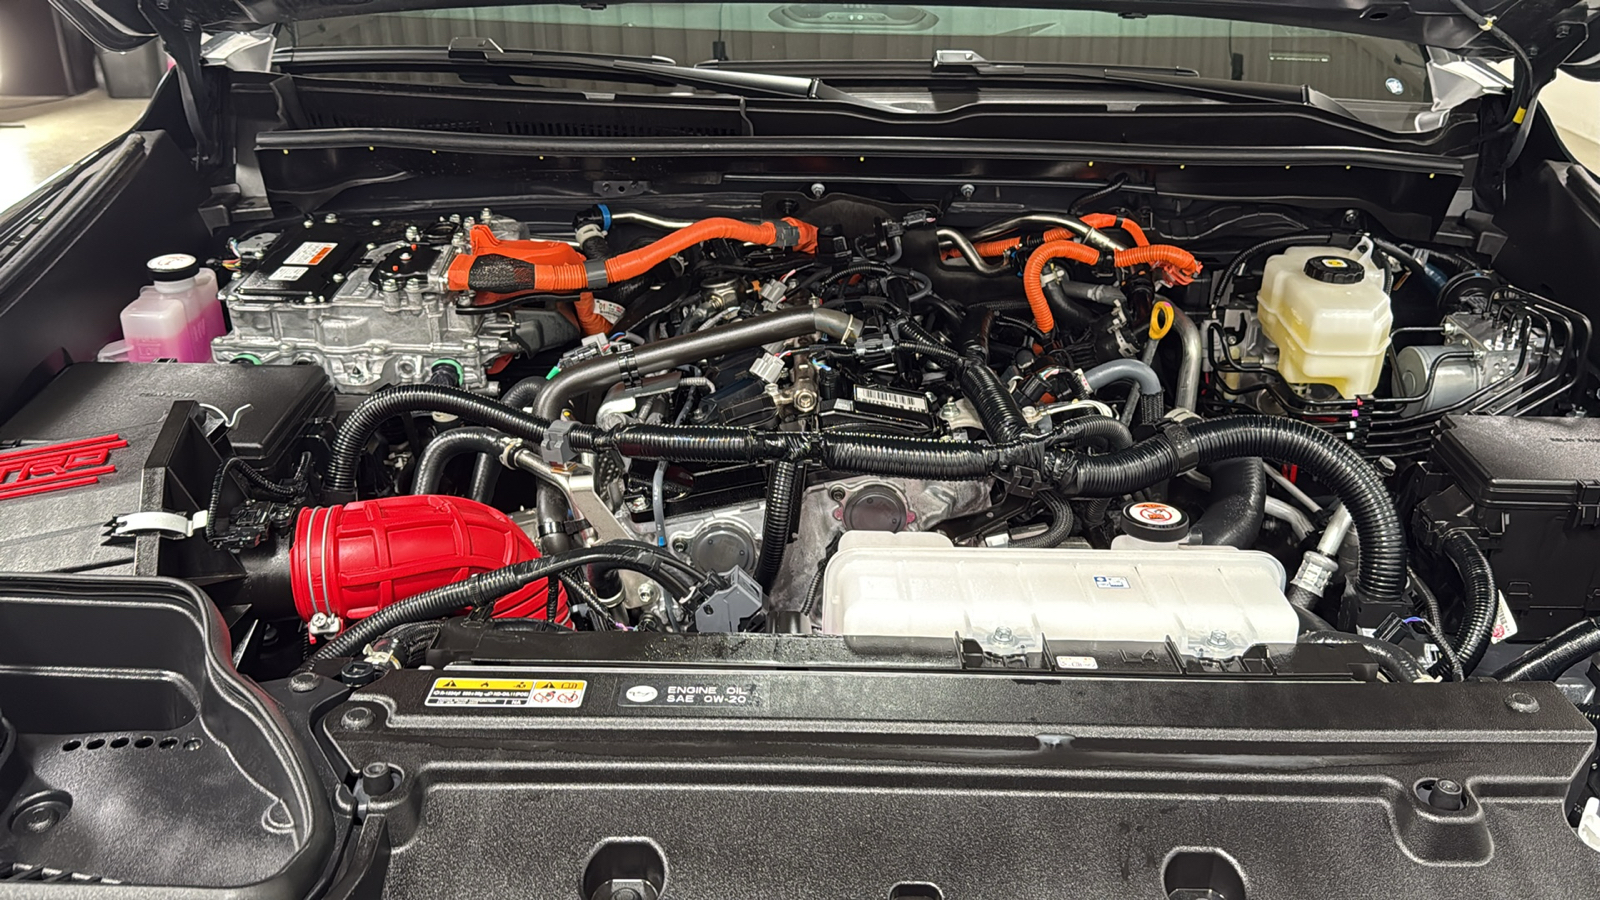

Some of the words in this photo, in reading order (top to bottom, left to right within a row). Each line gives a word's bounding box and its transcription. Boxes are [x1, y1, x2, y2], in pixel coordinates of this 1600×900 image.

[667, 685, 718, 695] ENGINE
[726, 685, 748, 695] OIL
[666, 695, 694, 703] SAE
[703, 695, 747, 704] 0W-20
